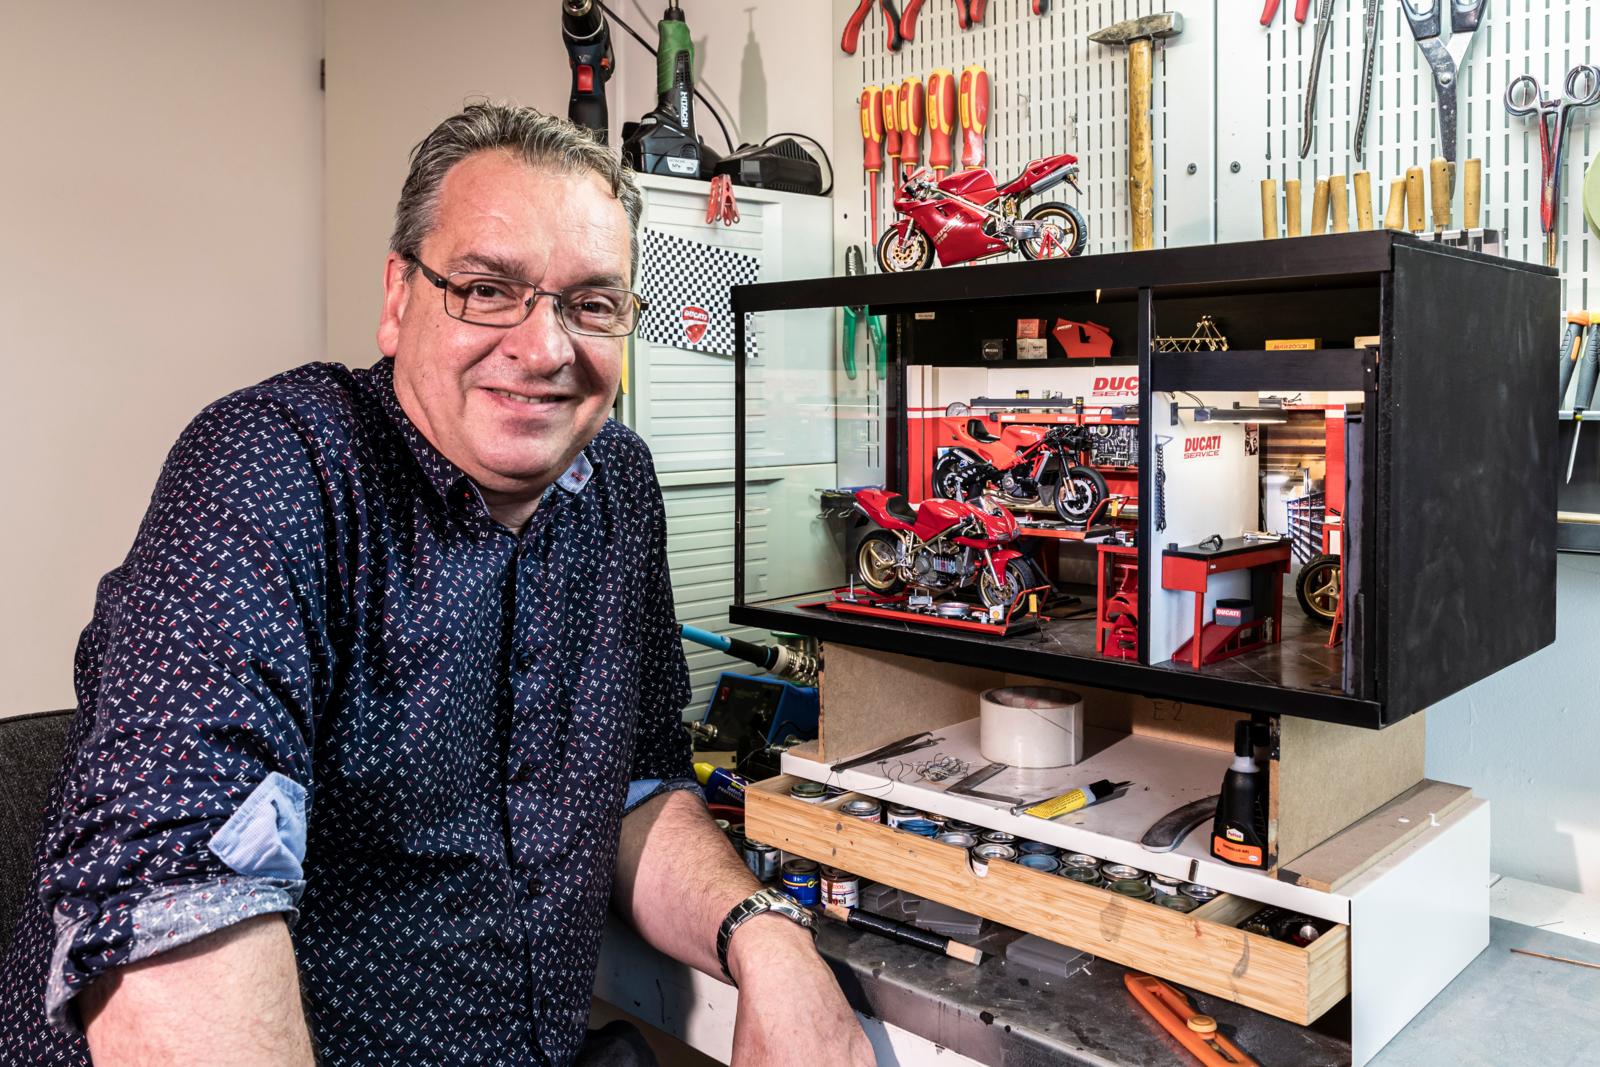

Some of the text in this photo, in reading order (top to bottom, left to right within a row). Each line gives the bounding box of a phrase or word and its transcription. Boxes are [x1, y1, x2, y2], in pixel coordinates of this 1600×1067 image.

[680, 91, 689, 128] HITACHI
[683, 309, 708, 320] DUCATI
[1184, 435, 1222, 453] DUCATI
[1183, 449, 1220, 460] SERVICE
[1216, 608, 1240, 617] DUCATI
